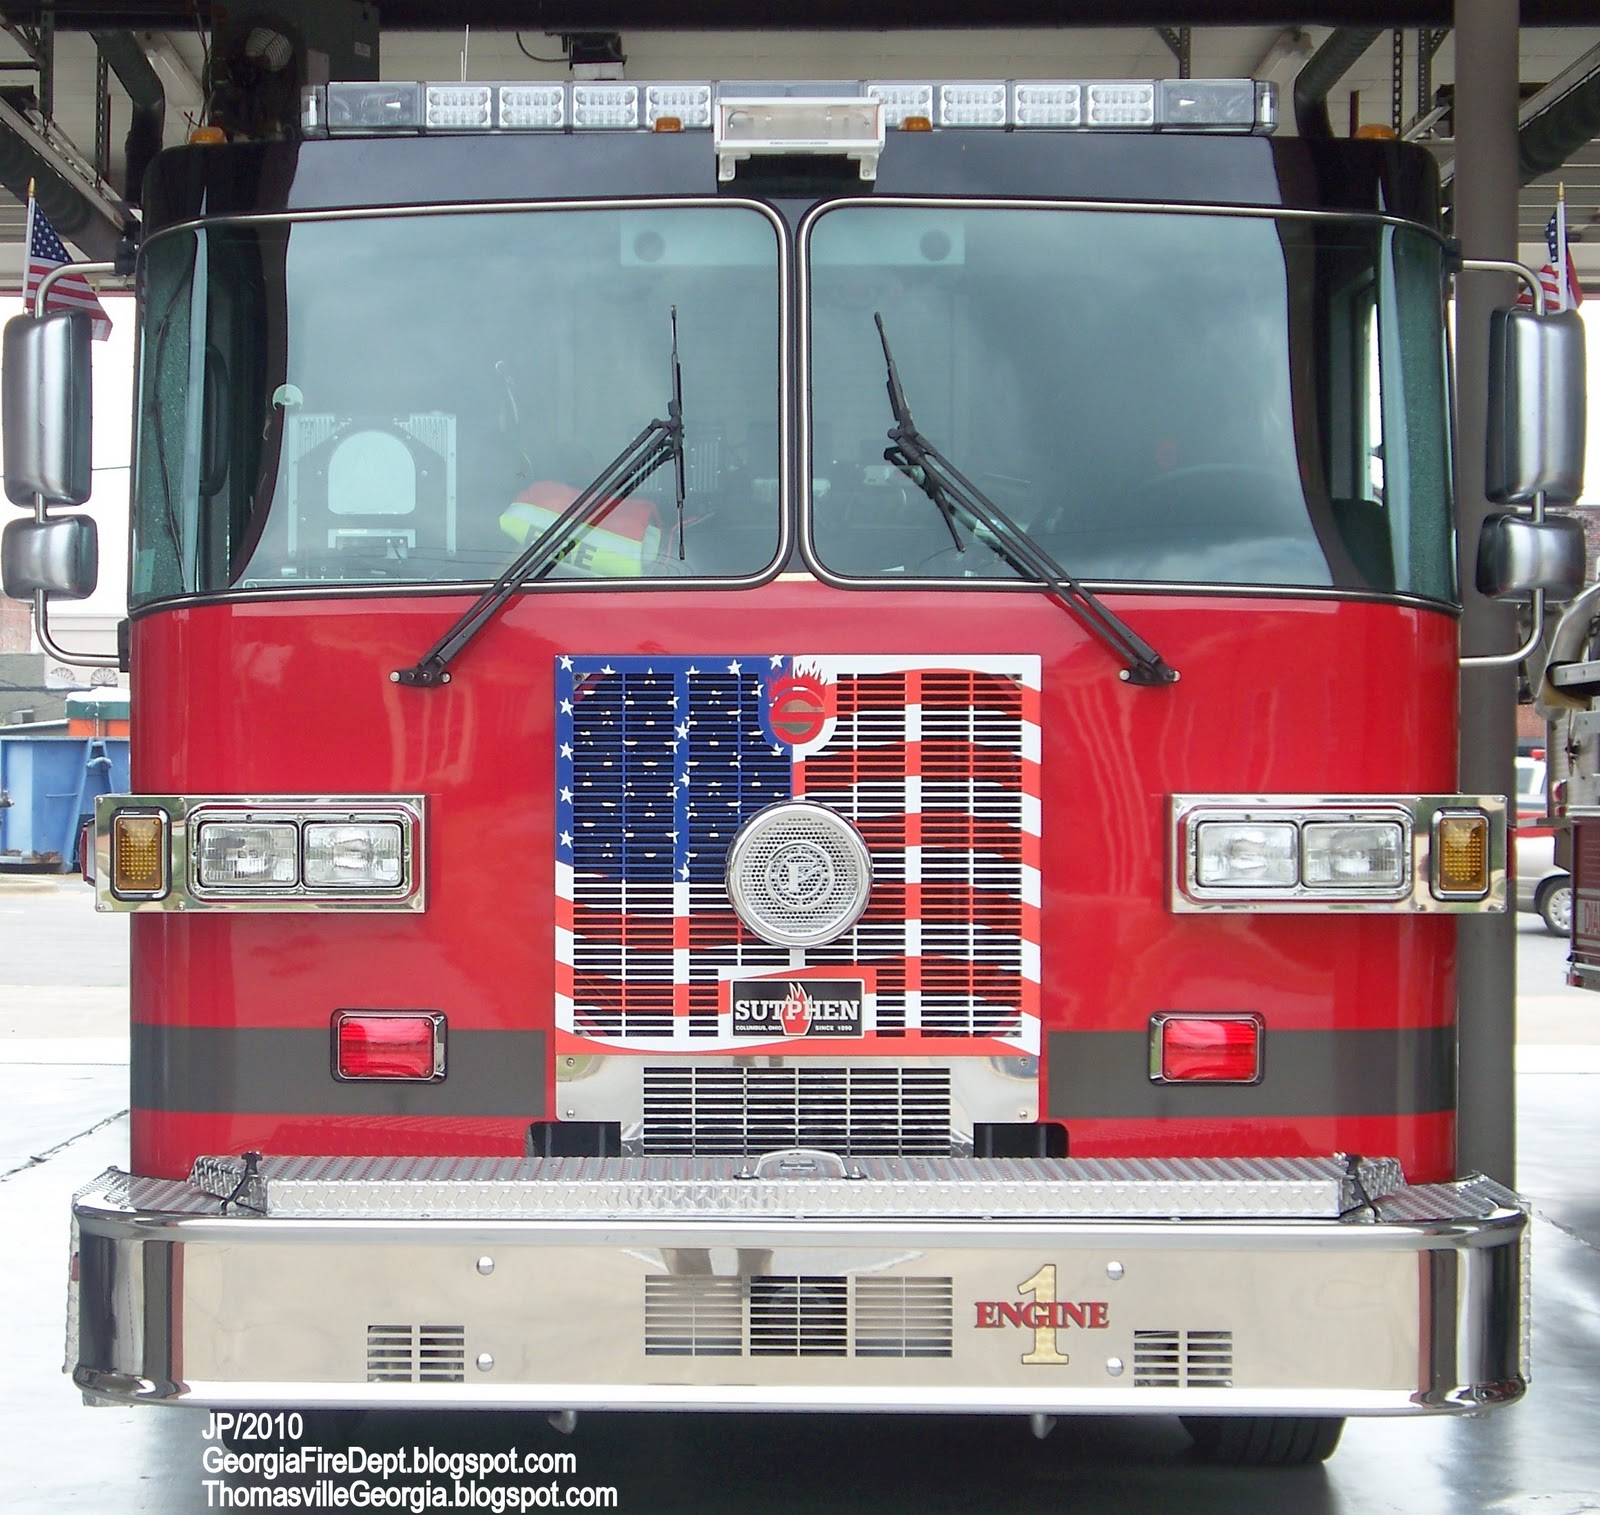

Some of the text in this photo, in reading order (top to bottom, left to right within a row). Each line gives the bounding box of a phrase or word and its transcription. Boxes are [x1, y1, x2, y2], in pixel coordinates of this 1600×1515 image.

[524, 524, 599, 571] FRE
[735, 999, 860, 1021] SUTPHEN
[974, 1301, 1110, 1329] ENGINE
[1017, 1264, 1069, 1365] 1
